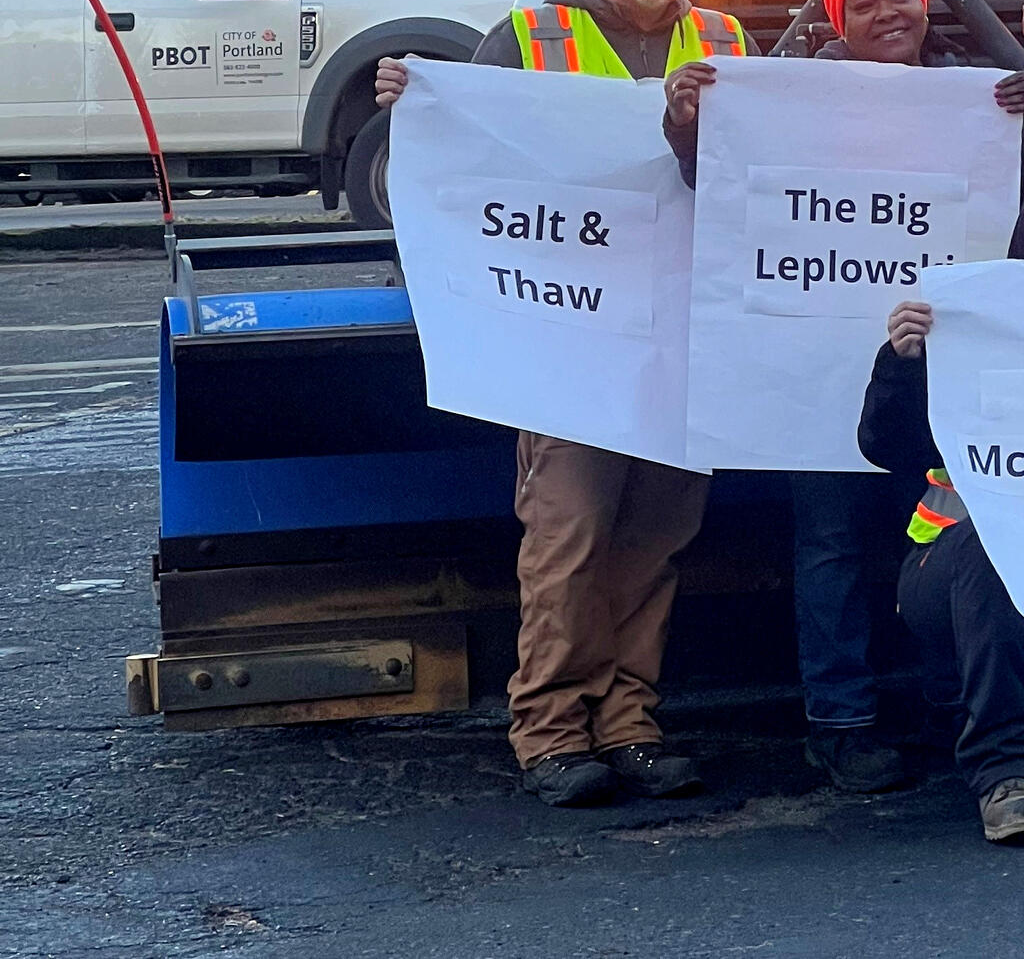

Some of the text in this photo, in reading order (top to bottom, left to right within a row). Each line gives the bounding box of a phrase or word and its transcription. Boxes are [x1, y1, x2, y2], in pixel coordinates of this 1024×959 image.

[152, 46, 210, 66] PBOT
[222, 31, 256, 41] CITY OF
[223, 42, 283, 57] Portland
[481, 202, 610, 247] Salt &
[784, 188, 931, 236] The Big
[488, 265, 603, 312] Thaw
[755, 248, 955, 292] Leplows
